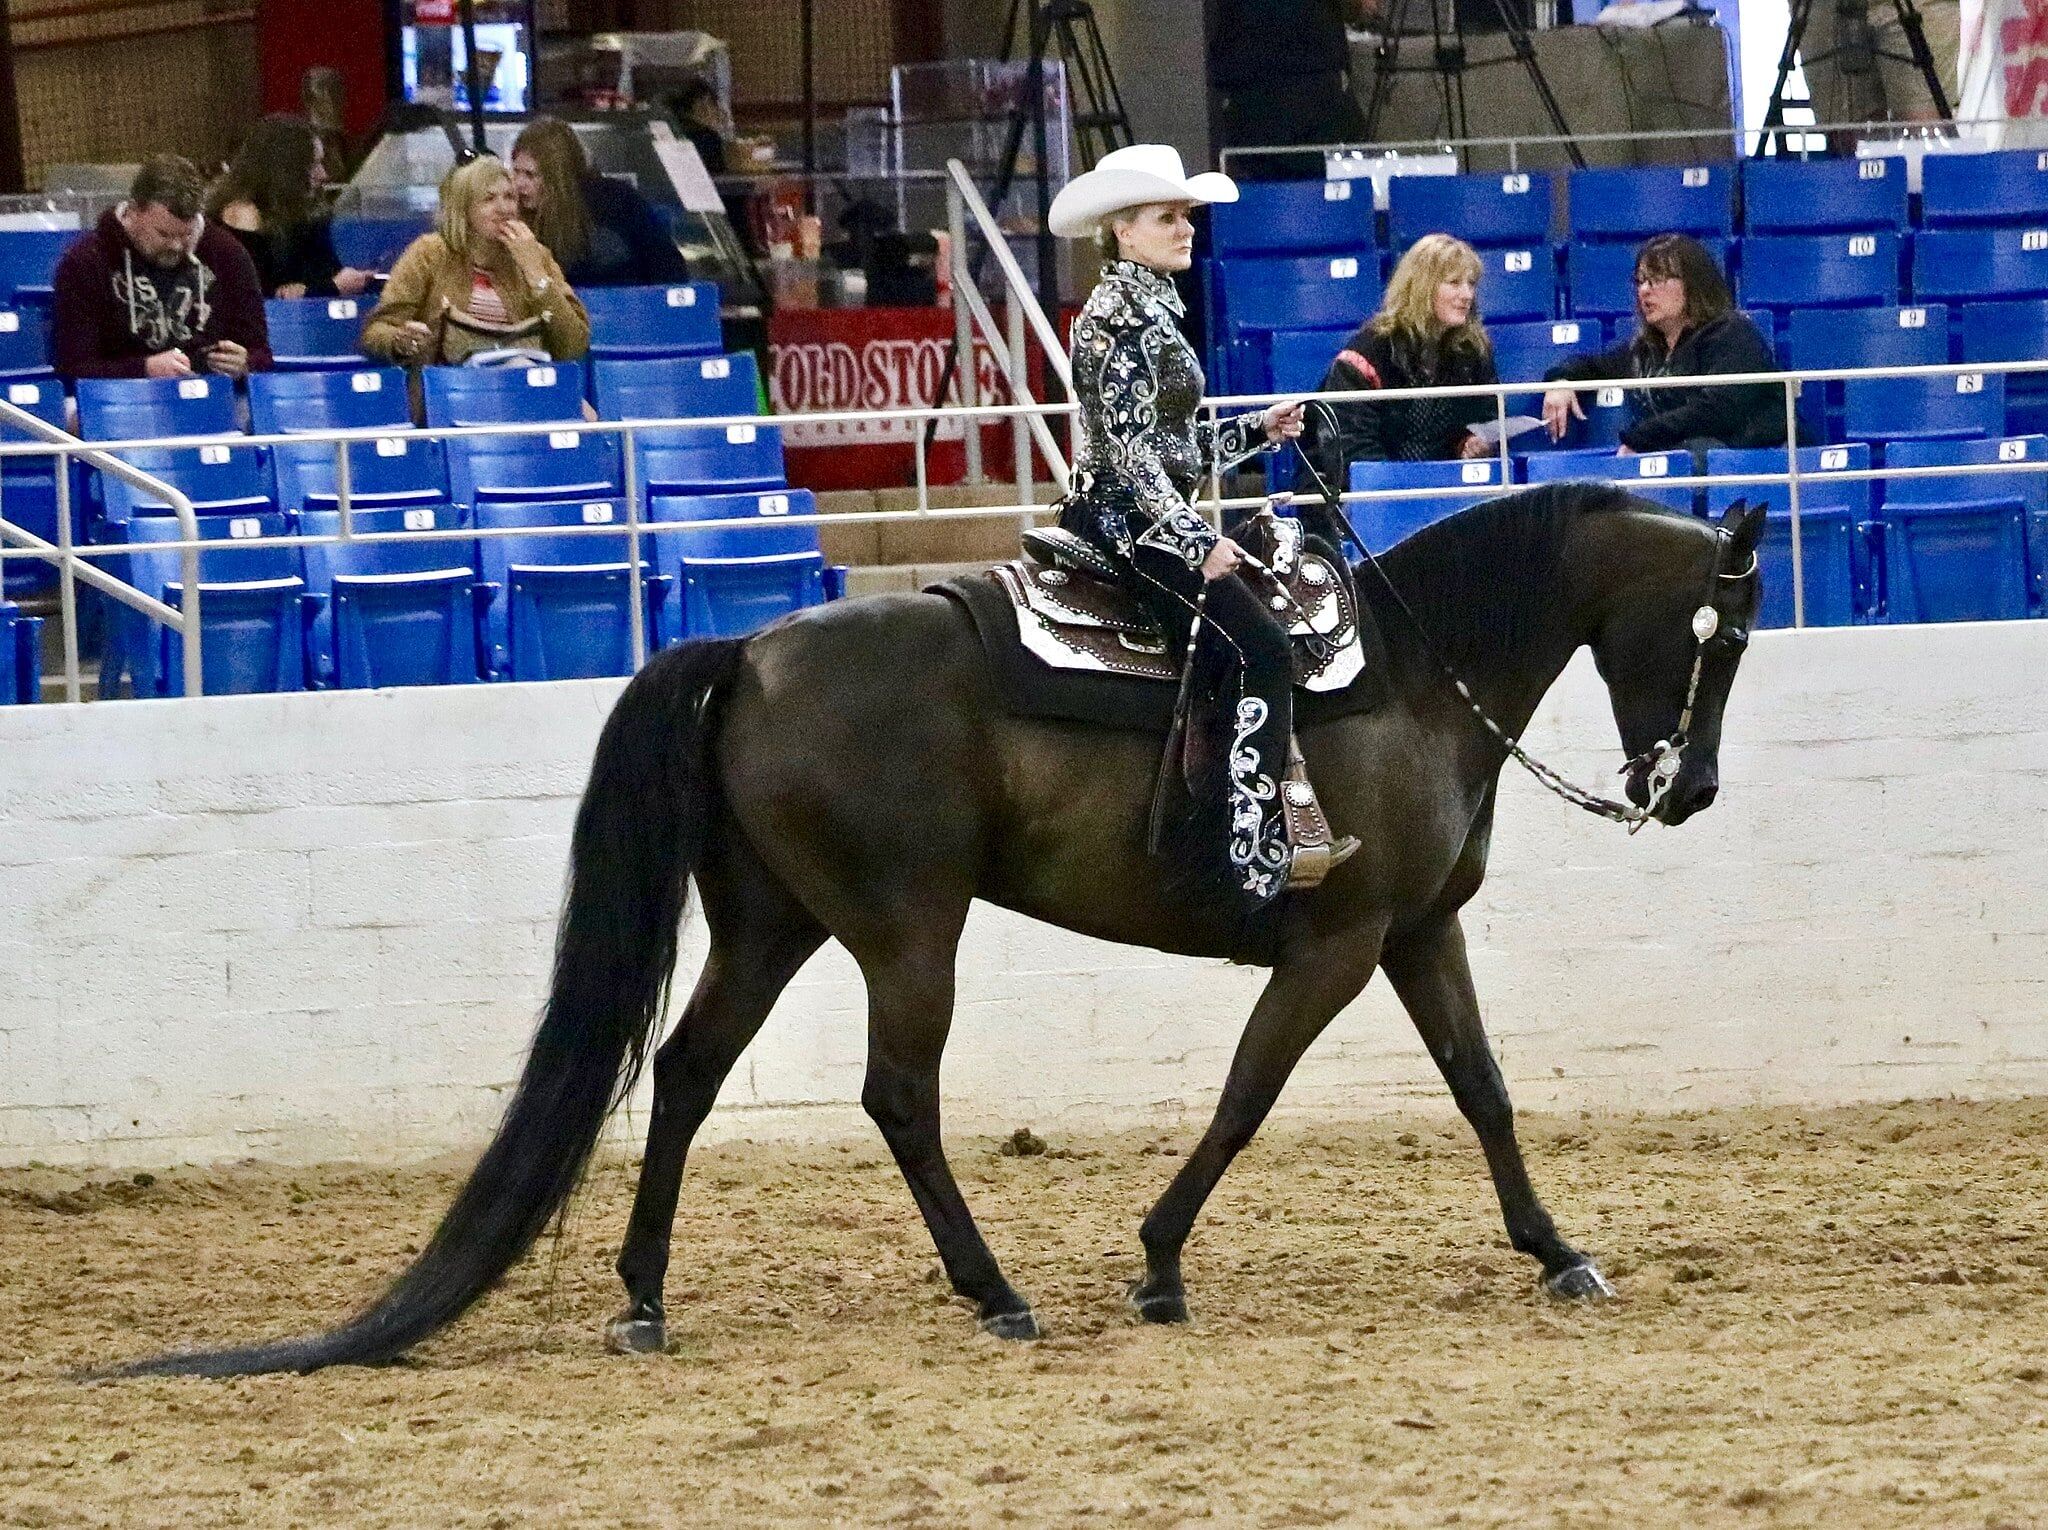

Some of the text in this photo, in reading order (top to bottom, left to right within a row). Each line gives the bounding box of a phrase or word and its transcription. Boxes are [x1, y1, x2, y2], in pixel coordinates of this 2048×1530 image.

[1865, 163, 1880, 177] 10
[1512, 175, 1520, 192] 8
[1855, 239, 1870, 254] 10
[2029, 234, 2041, 248] 11
[1909, 310, 1916, 325] 9
[1965, 374, 1974, 391] 8
[792, 417, 956, 437] CREAMEY
[2008, 444, 2016, 457] 8
[1649, 459, 1657, 473] 6
[1829, 452, 1838, 467] 7
[1472, 466, 1480, 479] 5
